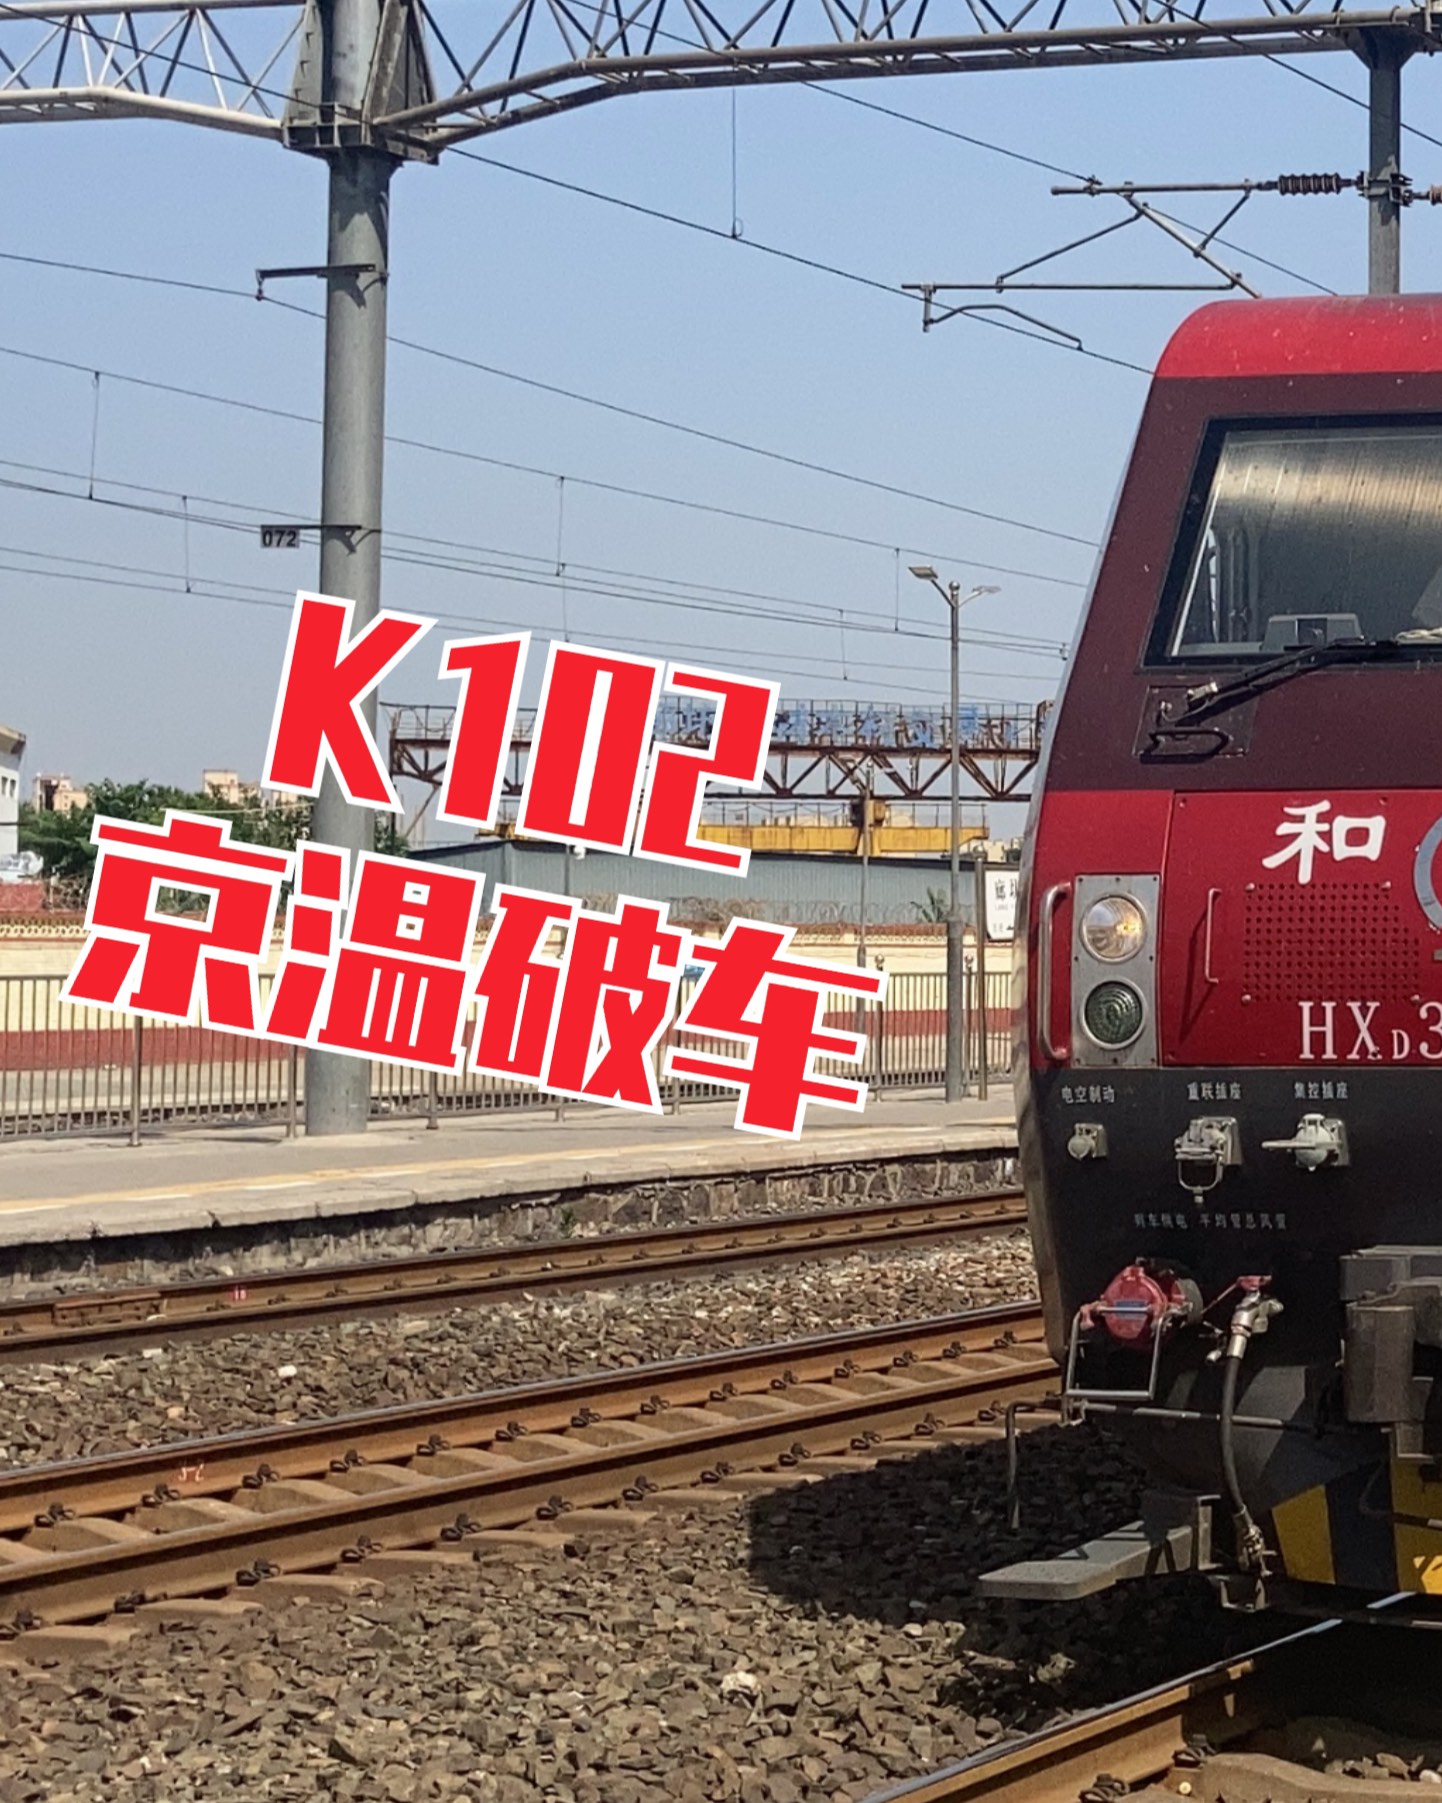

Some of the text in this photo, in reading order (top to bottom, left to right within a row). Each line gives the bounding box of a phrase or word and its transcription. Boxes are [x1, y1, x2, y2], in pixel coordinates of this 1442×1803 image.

[262, 530, 297, 548] 072
[1261, 799, 1388, 886] 和
[1061, 1084, 1115, 1104] 电空制动
[1187, 1081, 1241, 1101] 重联插座
